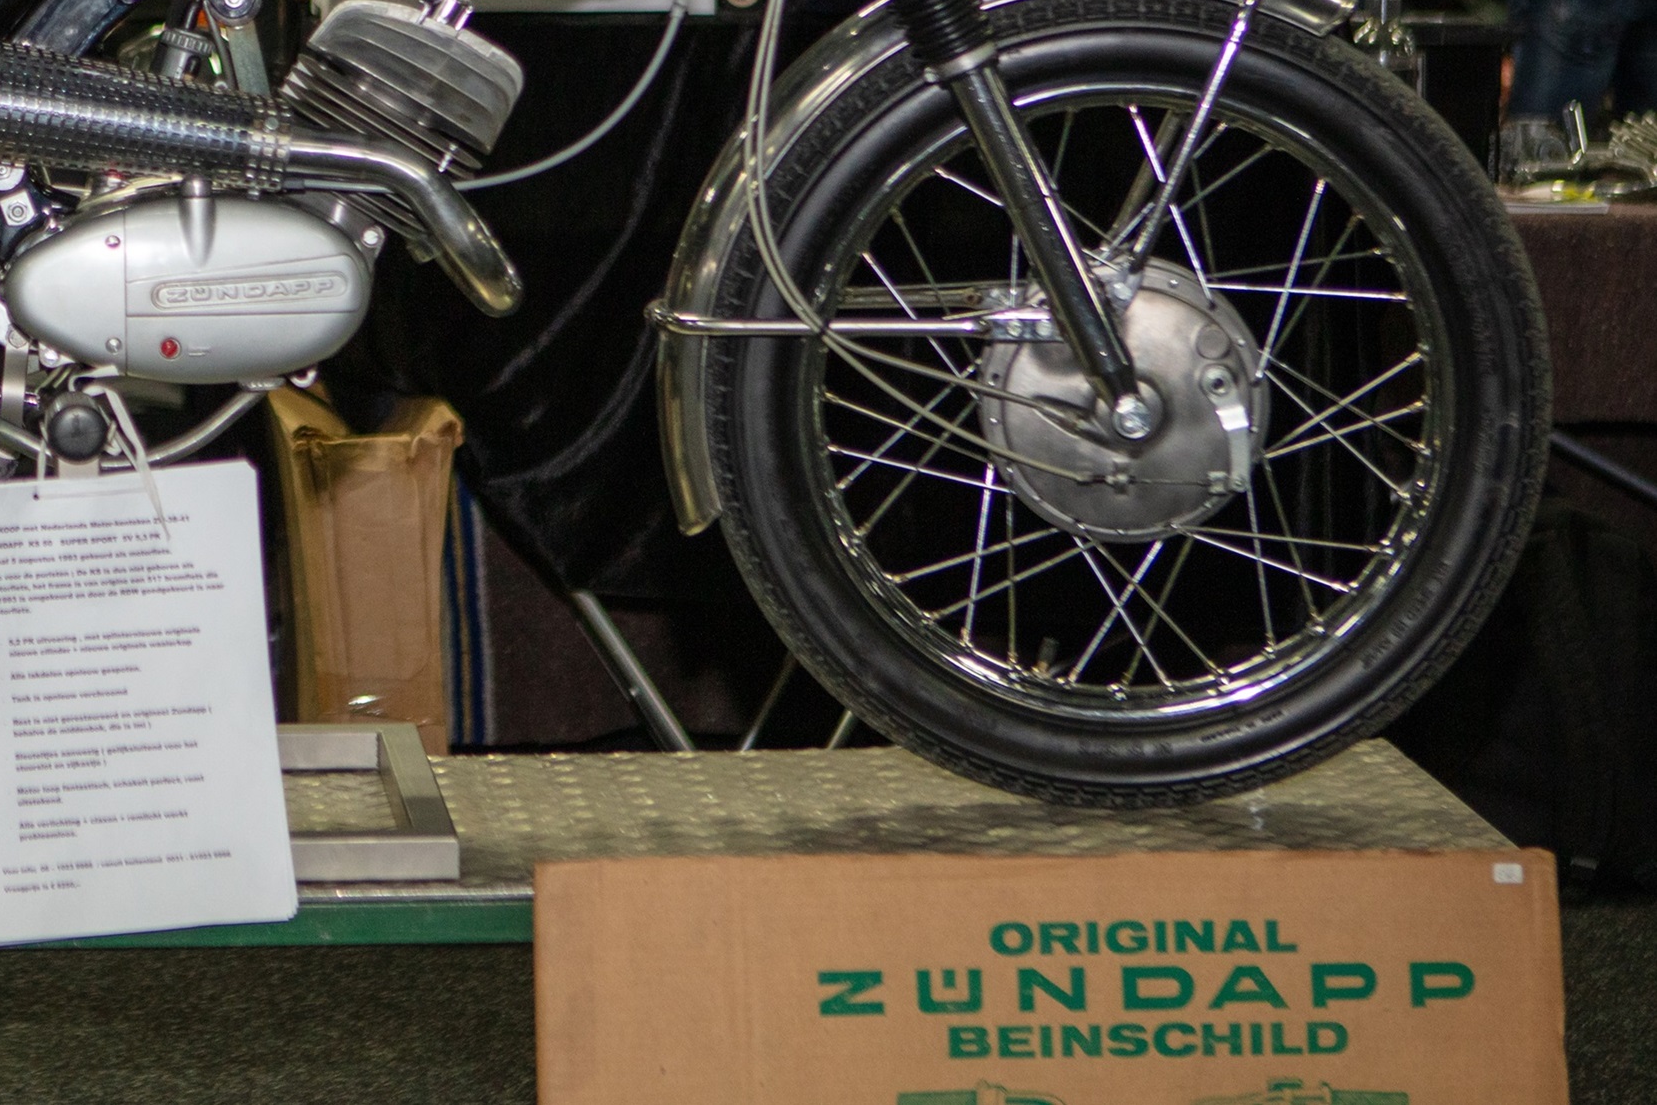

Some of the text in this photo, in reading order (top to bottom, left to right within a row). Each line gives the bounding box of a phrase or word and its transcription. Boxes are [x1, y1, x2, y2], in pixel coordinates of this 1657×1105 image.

[166, 278, 334, 304] ZÜNDAPP
[989, 920, 1296, 956] ORIGINAL
[948, 1021, 1348, 1060] BEINSCHILD
